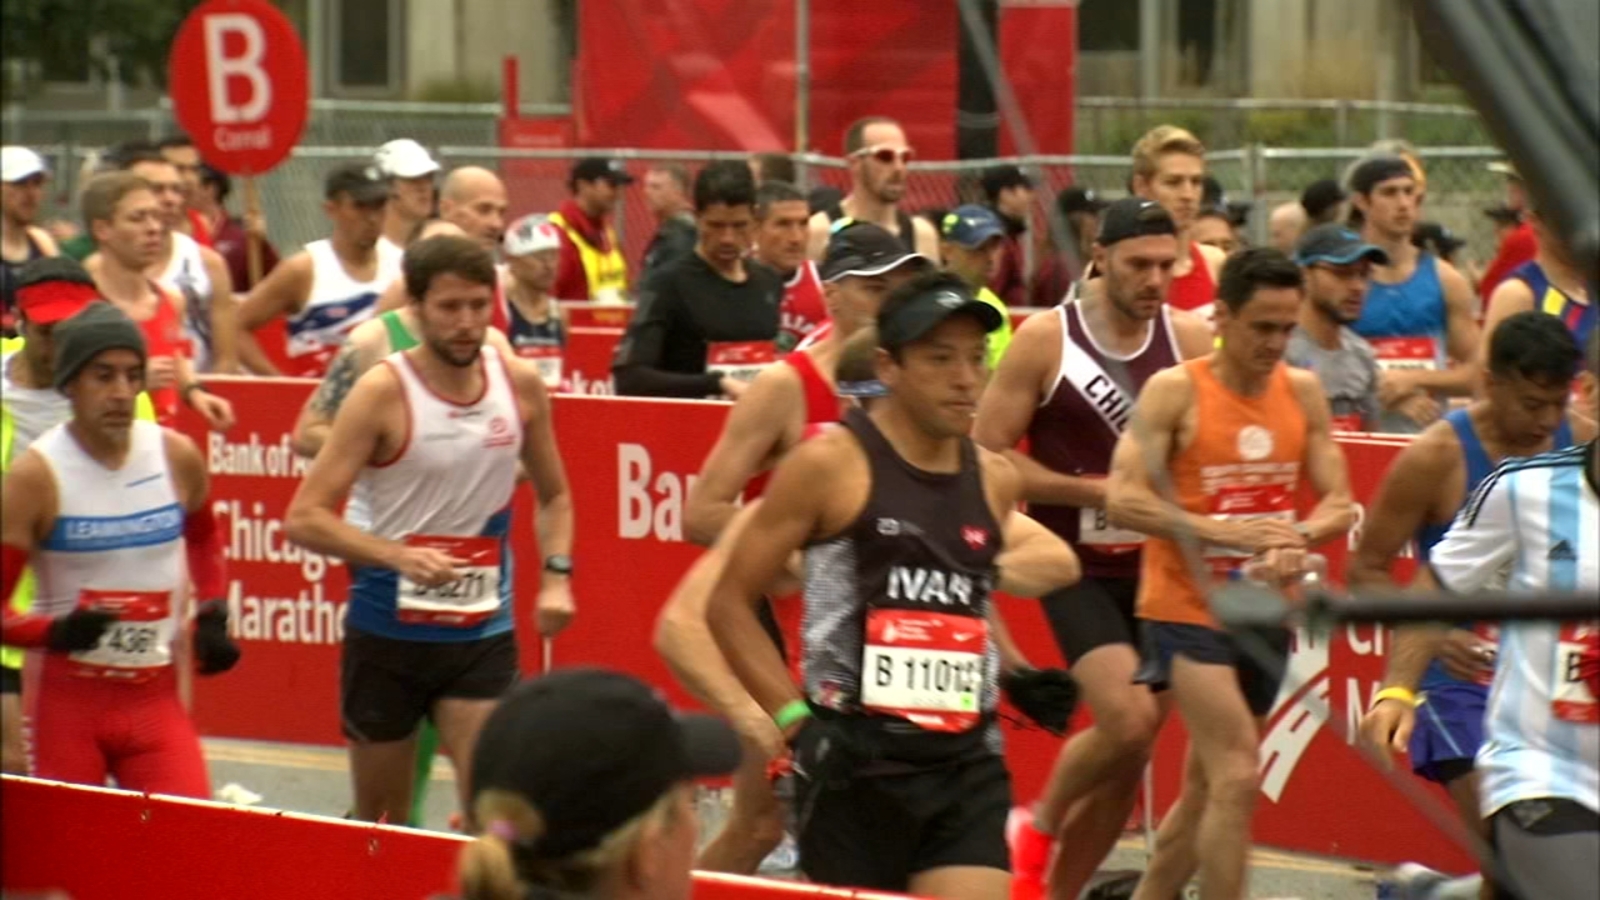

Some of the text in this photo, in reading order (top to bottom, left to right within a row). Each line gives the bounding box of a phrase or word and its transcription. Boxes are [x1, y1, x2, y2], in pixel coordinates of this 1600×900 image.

[204, 13, 272, 123] B
[208, 432, 264, 475] Bank
[266, 433, 291, 477] of
[213, 500, 345, 582] Chicag
[877, 654, 892, 687] B
